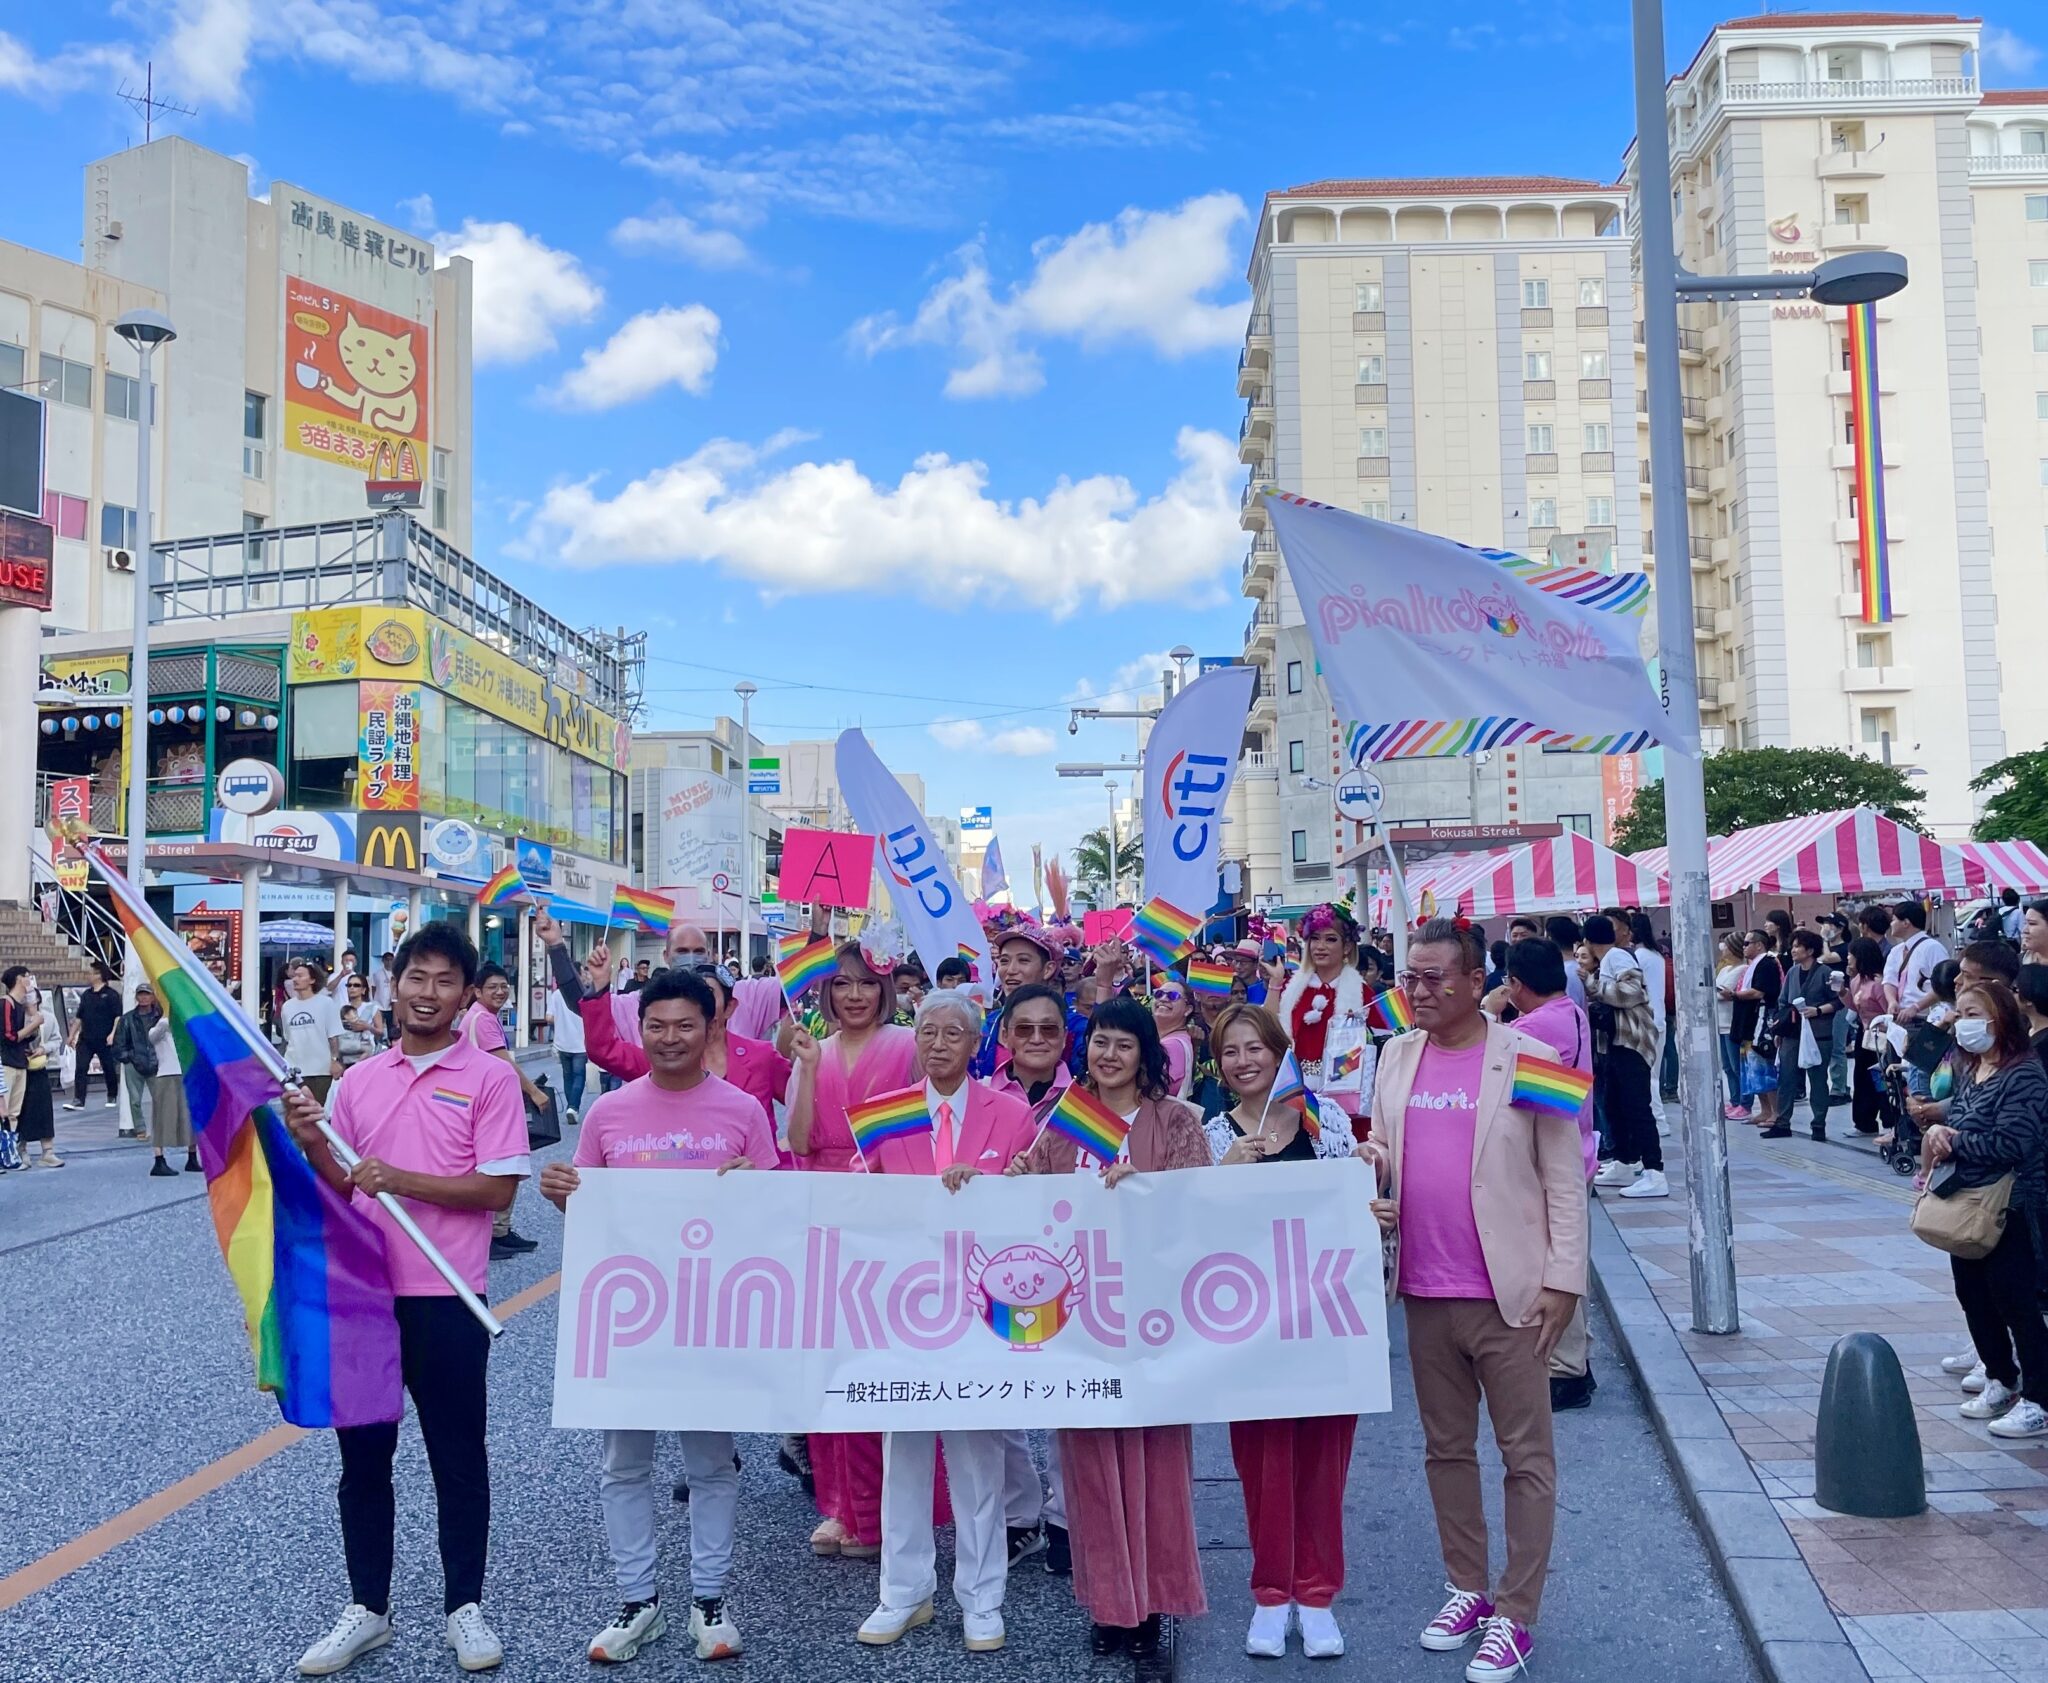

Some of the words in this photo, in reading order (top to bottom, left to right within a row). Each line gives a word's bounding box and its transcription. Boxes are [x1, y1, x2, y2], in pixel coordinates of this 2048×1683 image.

[1771, 251, 1820, 264] HOTEL
[1774, 306, 1823, 320] NAHA
[367, 711, 387, 798] 民謡ライブ
[668, 780, 709, 806] MUSIC
[255, 837, 284, 848] BLUE
[287, 836, 315, 849] SEAL
[1431, 827, 1476, 839] Kokusai
[1481, 826, 1522, 838] Street
[158, 845, 196, 856] Street
[803, 840, 845, 903] A
[573, 1200, 1369, 1379] pinkdot.ok
[824, 1376, 1124, 1404] 一般社団法人ピンクドット沖縄
